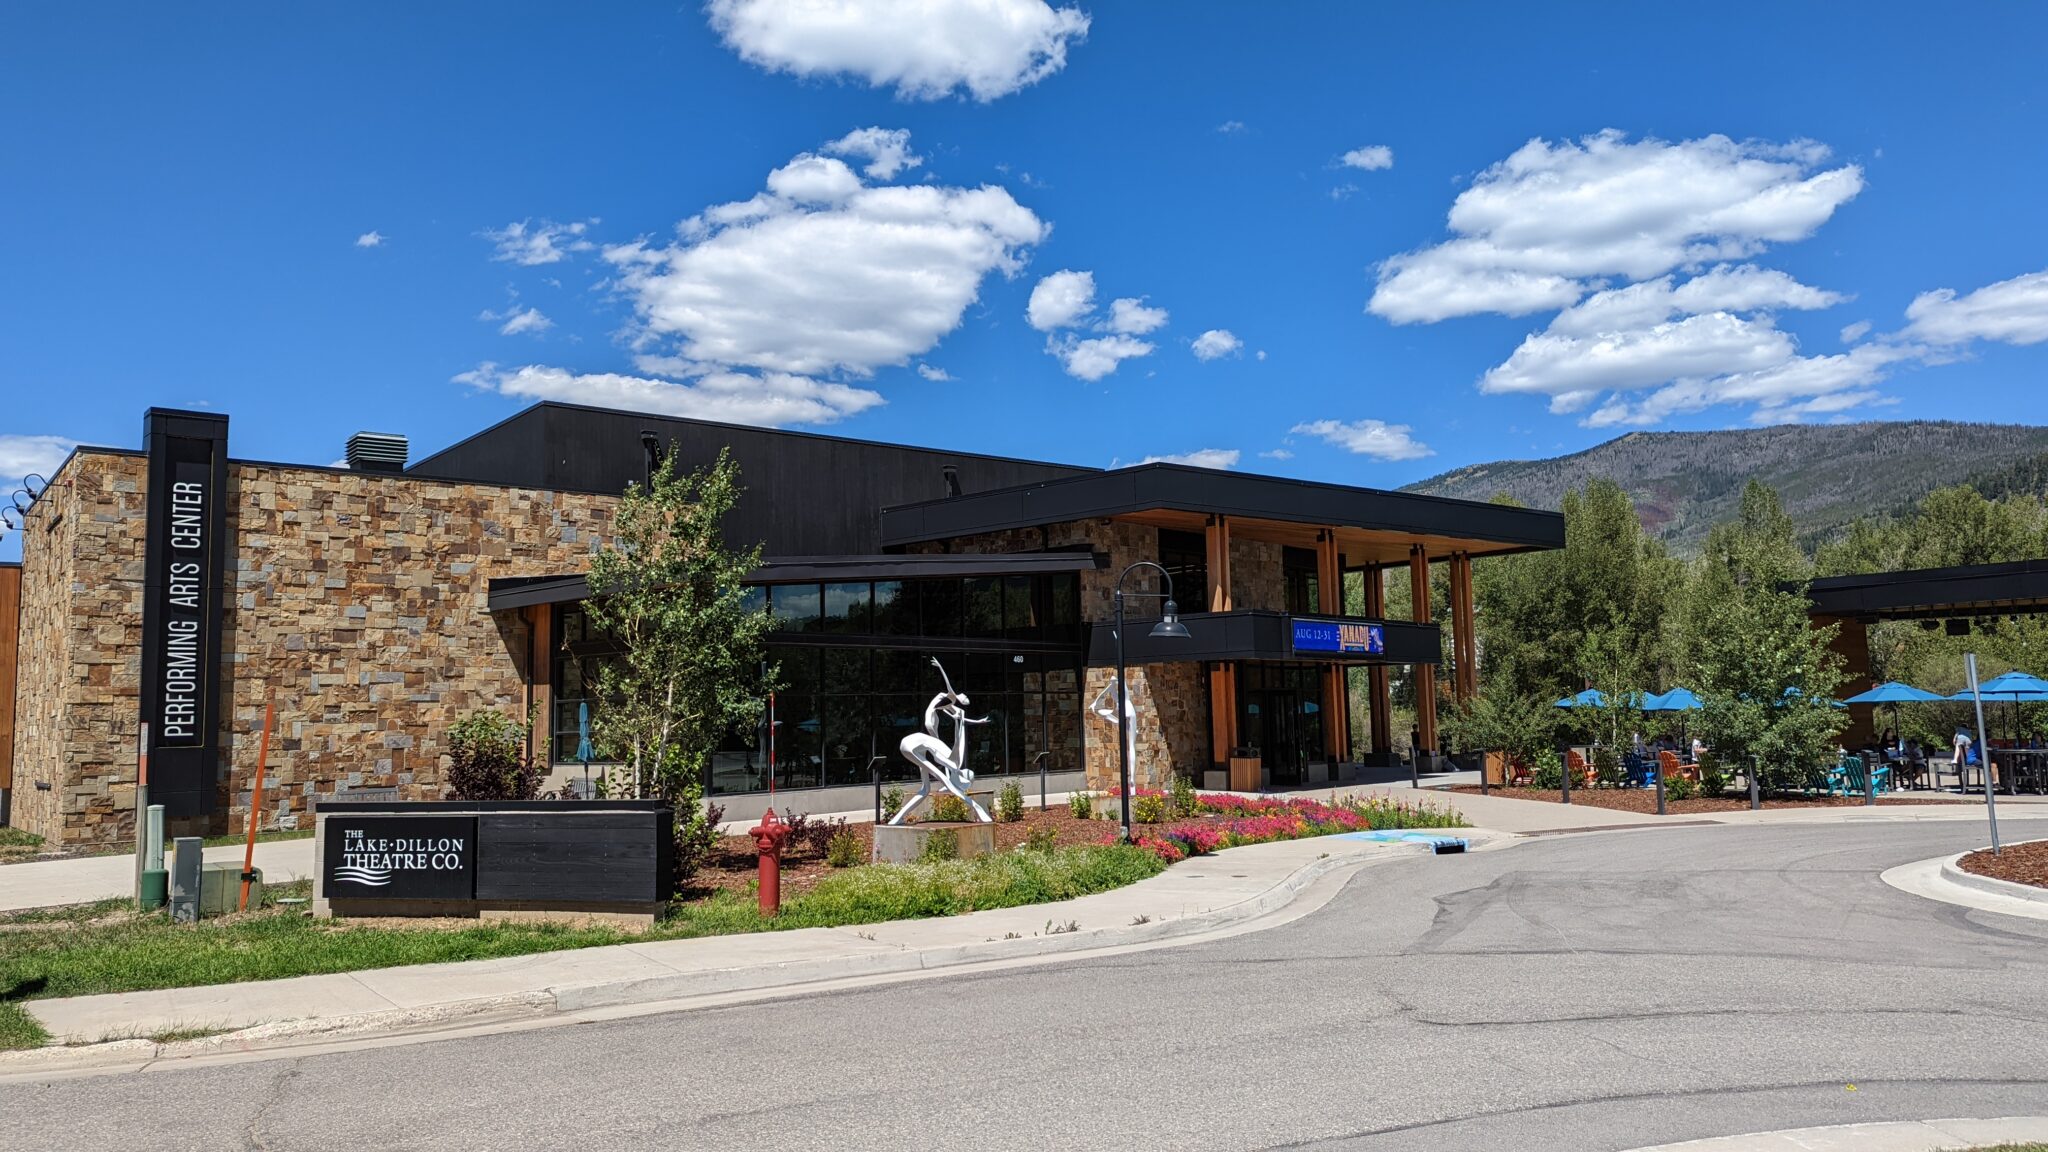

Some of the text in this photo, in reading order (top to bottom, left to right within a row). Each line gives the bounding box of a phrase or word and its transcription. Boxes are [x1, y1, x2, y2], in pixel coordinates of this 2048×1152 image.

[164, 481, 202, 737] PERFORMING ARTS CENTER
[1295, 628, 1331, 640] AUG 12-31
[1339, 624, 1370, 651] XANADU
[1013, 655, 1024, 663] 460
[344, 829, 364, 838] THE
[343, 853, 463, 870] THEATRE CO.
